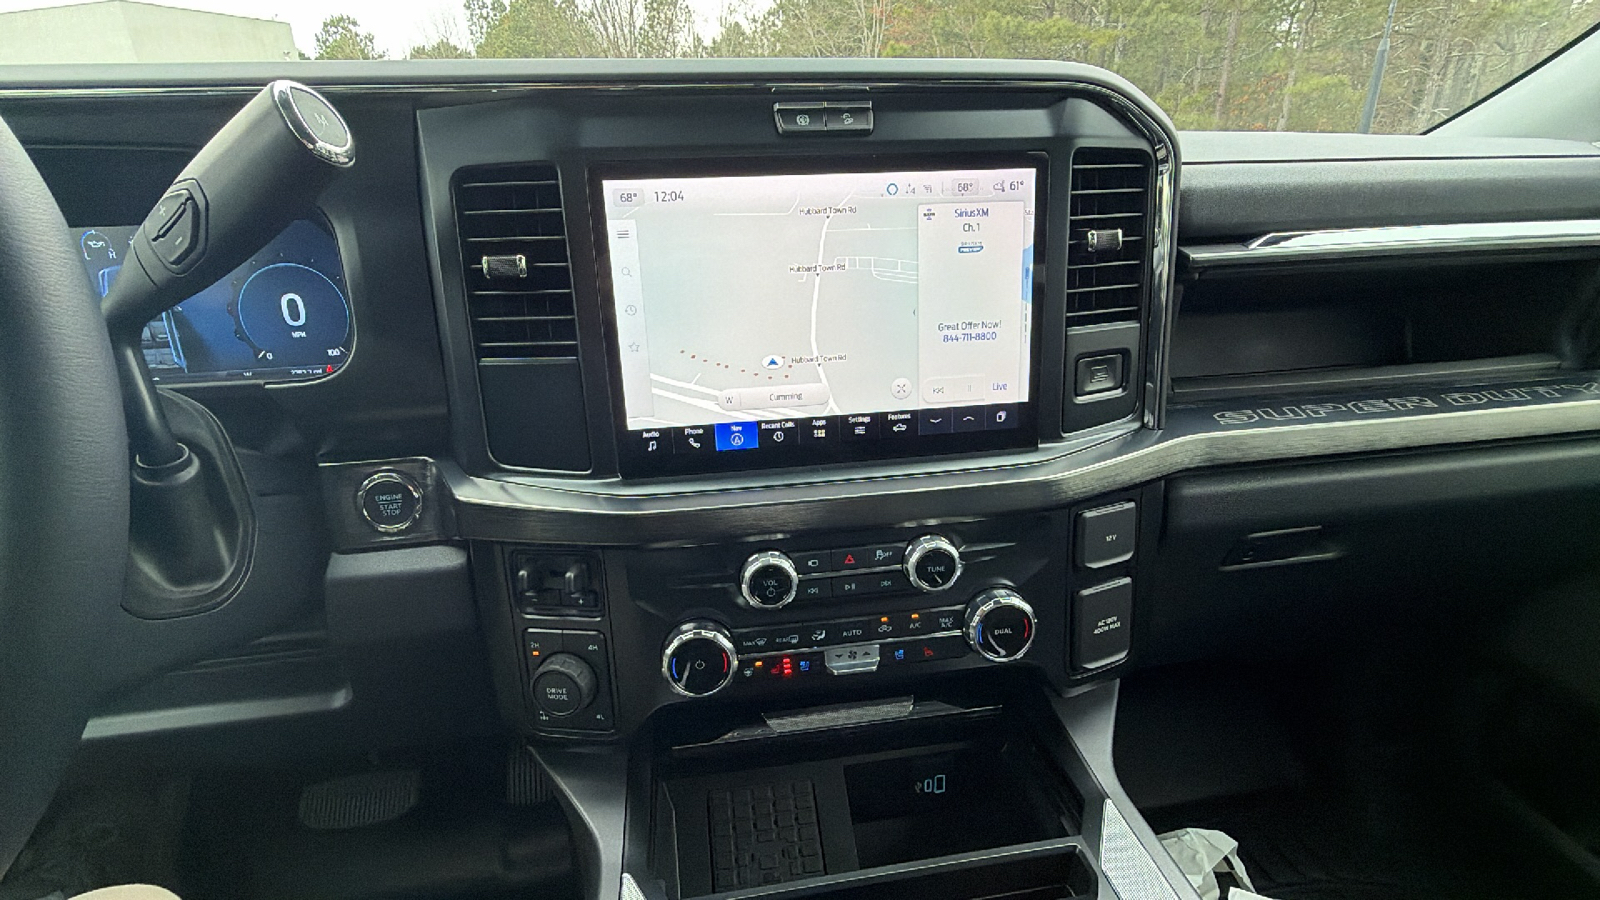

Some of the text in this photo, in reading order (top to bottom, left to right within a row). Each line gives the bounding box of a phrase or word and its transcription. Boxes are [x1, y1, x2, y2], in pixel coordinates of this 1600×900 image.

[957, 182, 974, 192] 68°
[1009, 180, 1025, 191] 61°
[620, 193, 638, 203] 68°
[654, 191, 684, 202] 12:04
[799, 206, 857, 216] Hubbard Town Rd
[962, 222, 976, 232] Ch.
[789, 263, 846, 273] Hubbard Town Rd
[280, 293, 306, 327] 0
[937, 319, 1002, 332] Great Offer Now!
[942, 331, 997, 343] 844-711-8800
[266, 352, 273, 360] 0
[327, 348, 340, 356] 100
[791, 355, 819, 365] Hubbard
[819, 354, 837, 363] Town
[992, 381, 1008, 391] Live
[725, 396, 734, 404] W
[769, 392, 803, 403] Cumming
[1213, 382, 1600, 425] SUPER DUTY
[848, 415, 871, 424] Settings
[887, 413, 911, 421] Features
[761, 421, 781, 430] Recent
[812, 419, 826, 428] Apps
[643, 430, 660, 438] Audio
[684, 427, 704, 436] Phone
[374, 493, 403, 502] ENGINE
[379, 502, 402, 511] START
[382, 509, 402, 517] STOP
[1105, 534, 1118, 542] 12V
[926, 565, 946, 573] TUNE
[762, 579, 779, 587] VOL
[939, 616, 954, 624] MAX
[909, 621, 922, 629] A/C
[940, 621, 954, 629] A/C
[842, 629, 862, 638] AUTO
[994, 627, 1013, 635] DUAL
[529, 641, 540, 649] 2H
